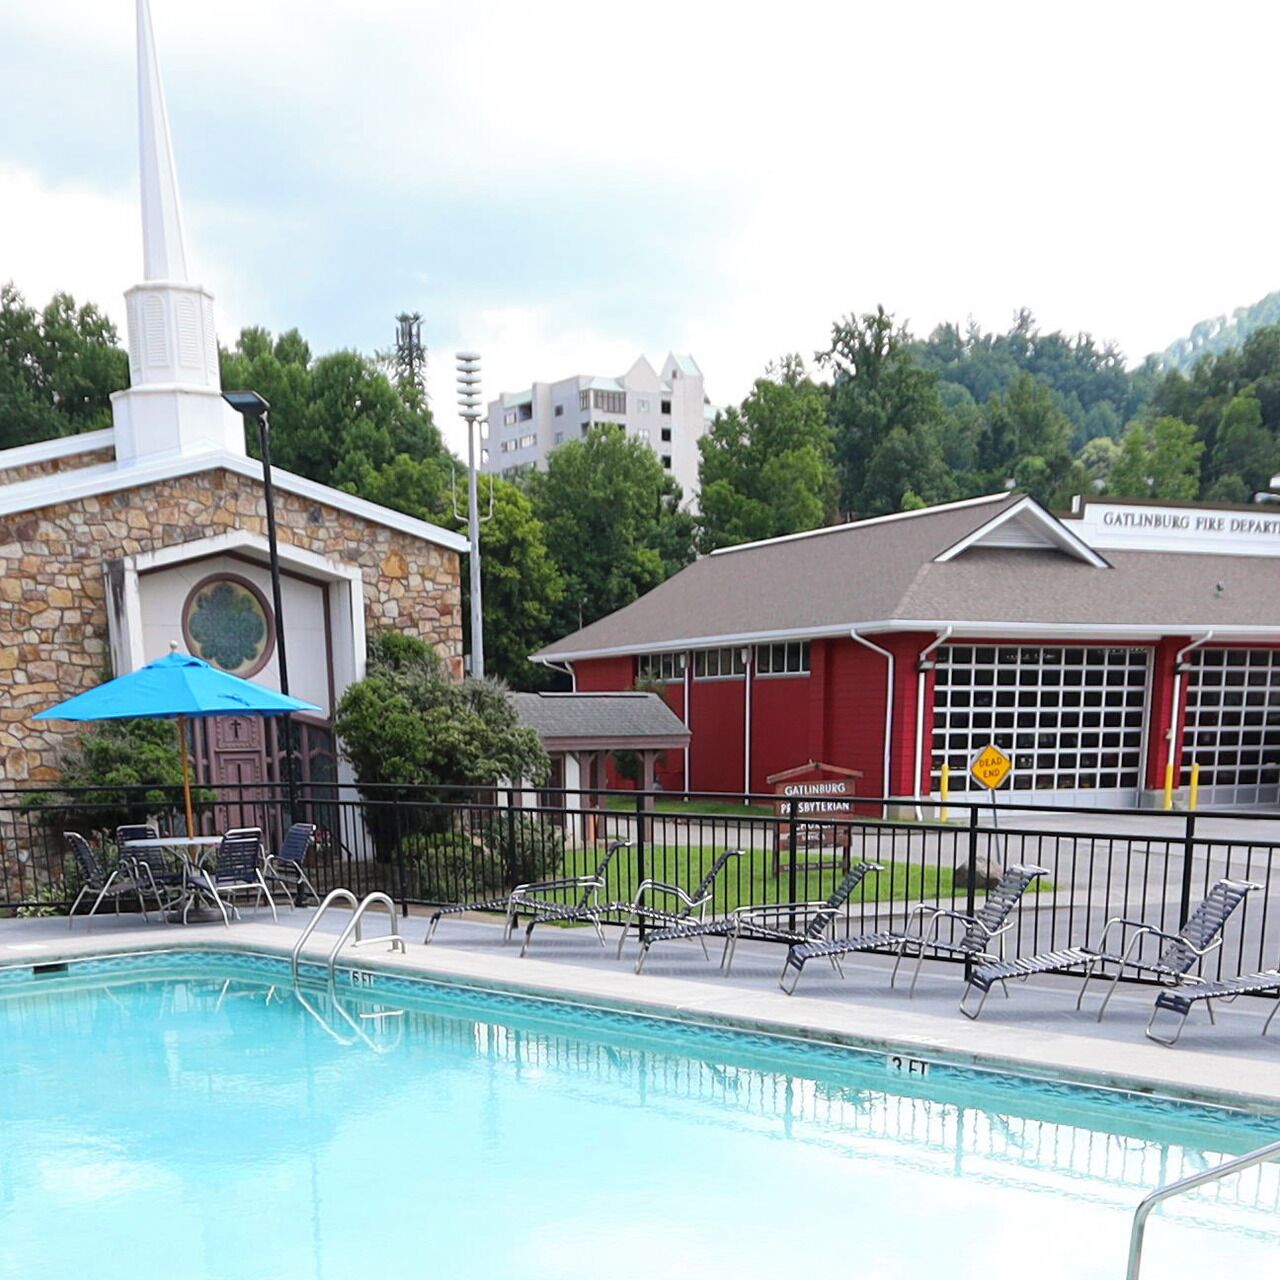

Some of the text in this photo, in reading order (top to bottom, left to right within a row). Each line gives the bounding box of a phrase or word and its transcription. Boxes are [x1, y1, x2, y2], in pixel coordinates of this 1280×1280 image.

[1103, 511, 1190, 529] GATLINBURG
[1195, 516, 1224, 532] FIRE
[979, 757, 1002, 768] DEAD
[983, 769, 1000, 778] END
[784, 782, 846, 796] GATLINBURG
[781, 801, 850, 814] PRSBYTERIAN
